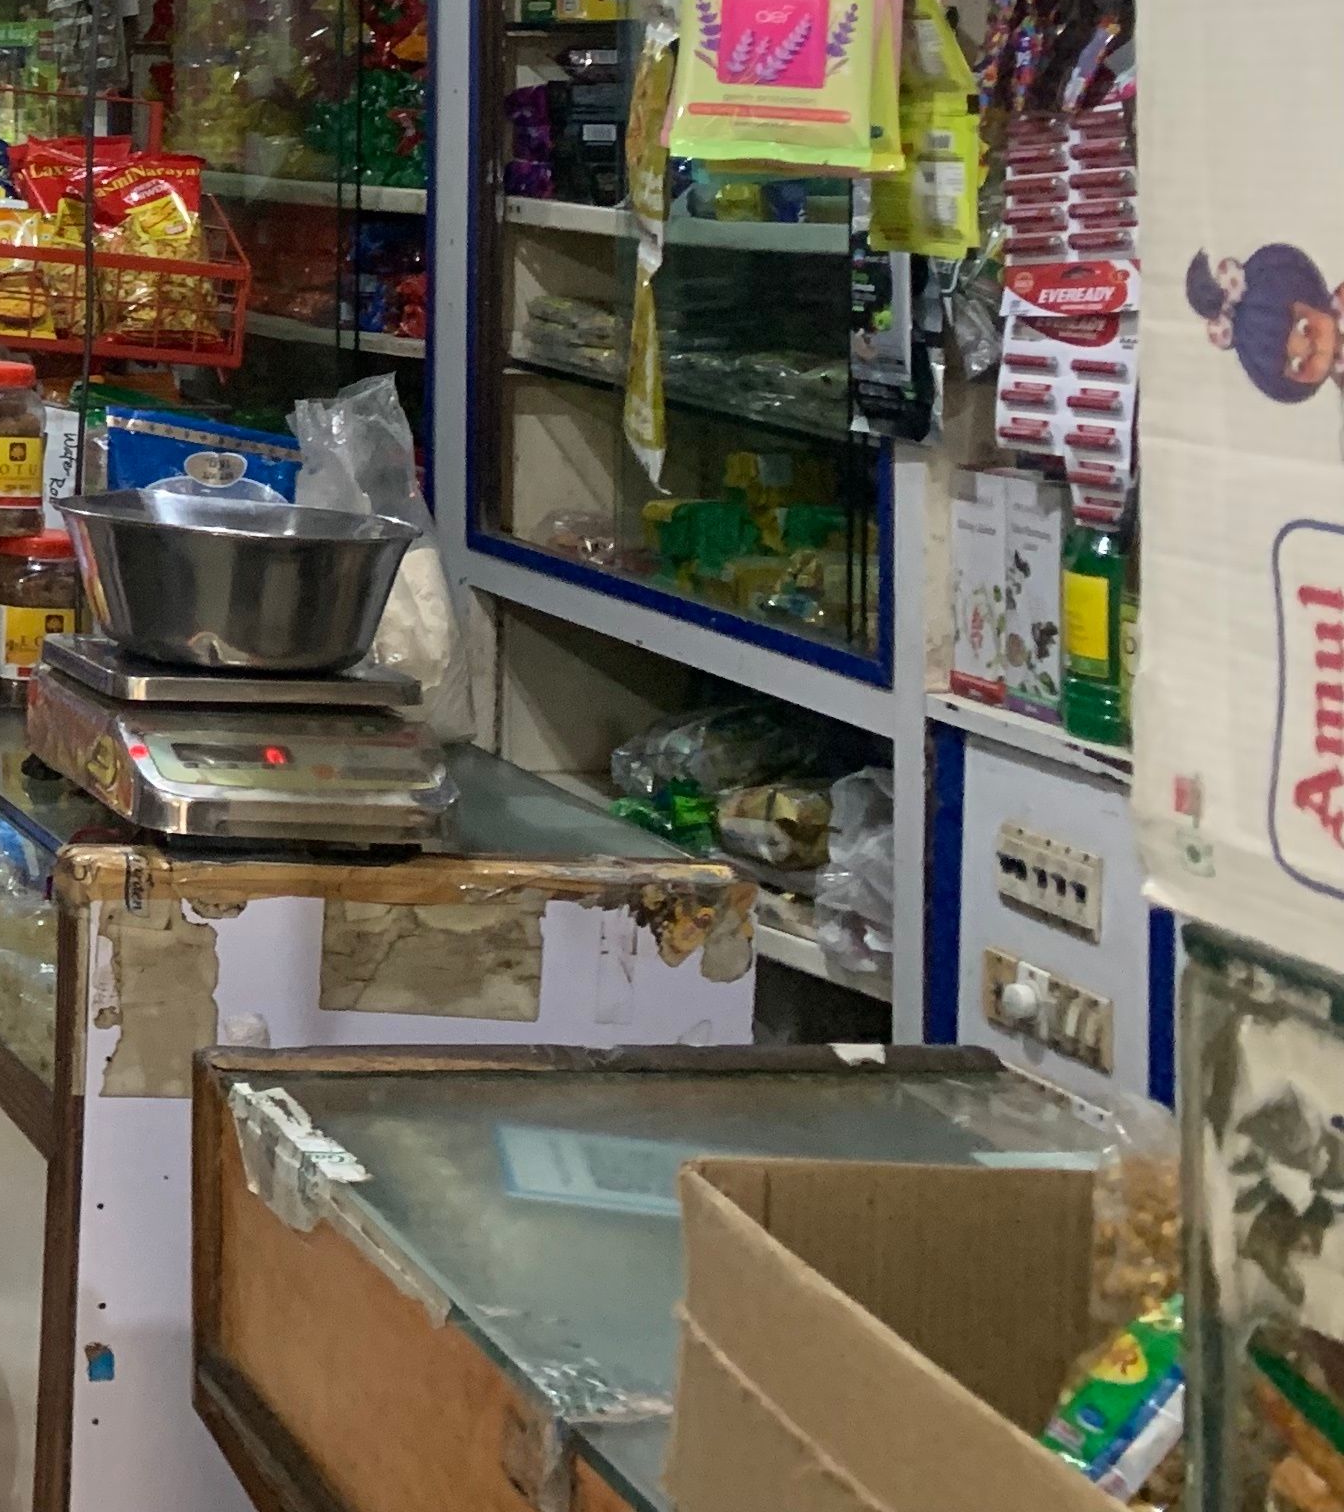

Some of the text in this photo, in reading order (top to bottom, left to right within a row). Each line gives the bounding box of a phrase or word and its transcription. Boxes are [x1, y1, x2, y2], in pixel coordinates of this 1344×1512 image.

[754, 5, 794, 24] aer
[1037, 287, 1116, 305] EVEREADY
[62, 432, 78, 479] Wafer
[1293, 584, 1344, 849] Amul
